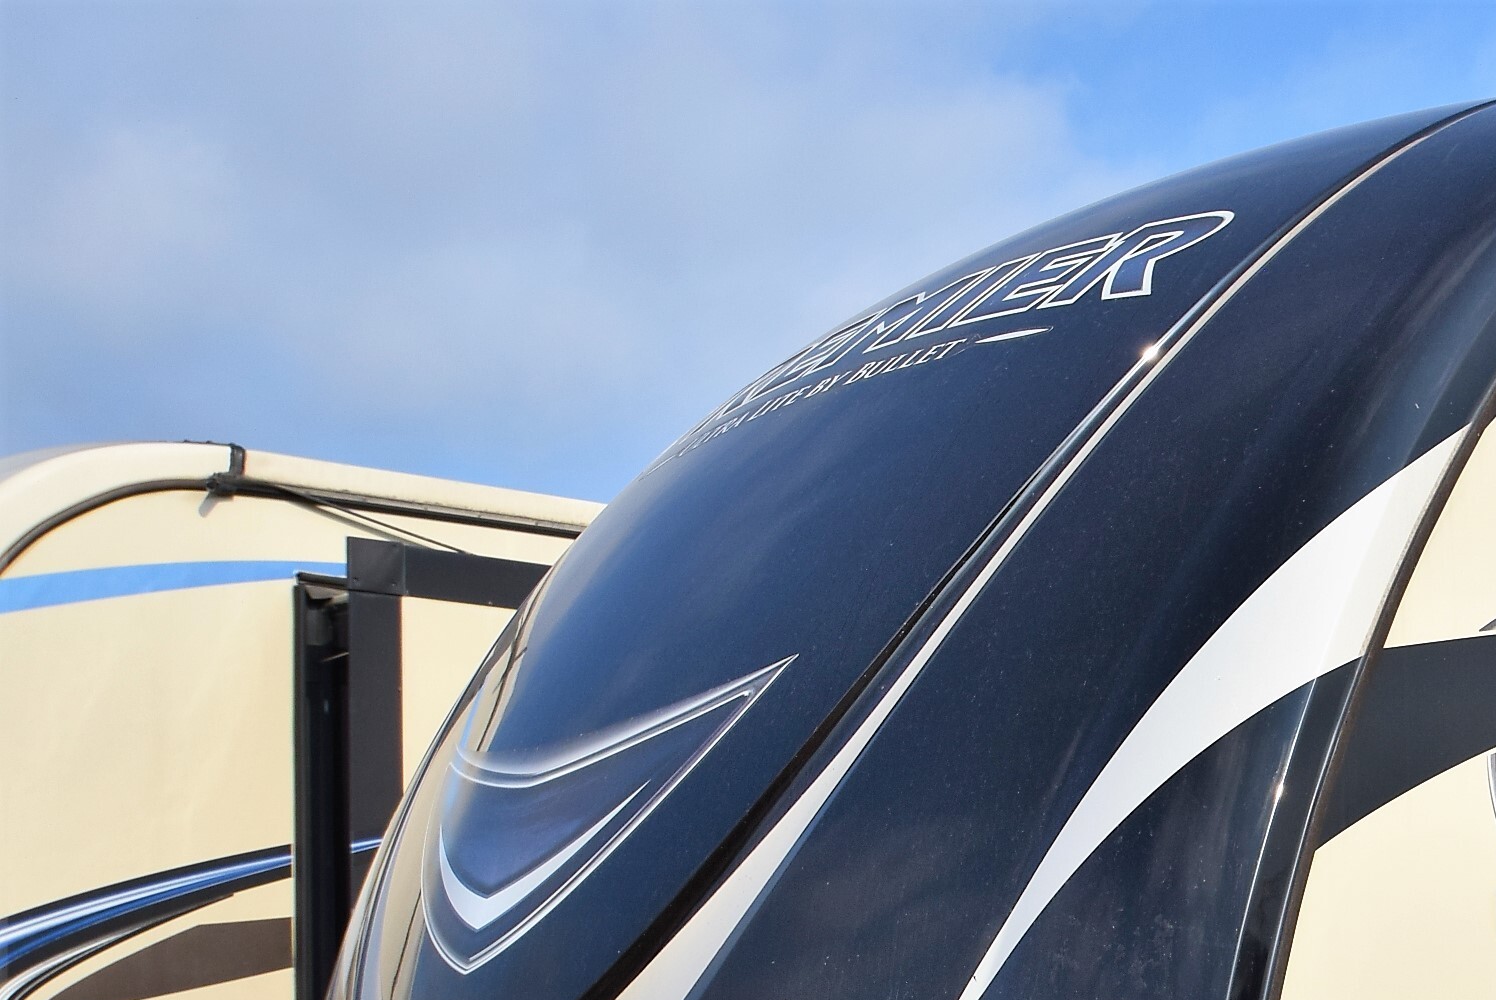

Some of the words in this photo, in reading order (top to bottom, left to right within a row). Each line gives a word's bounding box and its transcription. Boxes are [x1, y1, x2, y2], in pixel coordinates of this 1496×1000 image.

[746, 384, 812, 422] LITE
[804, 370, 852, 399] BY
[843, 338, 967, 386] BULLET
